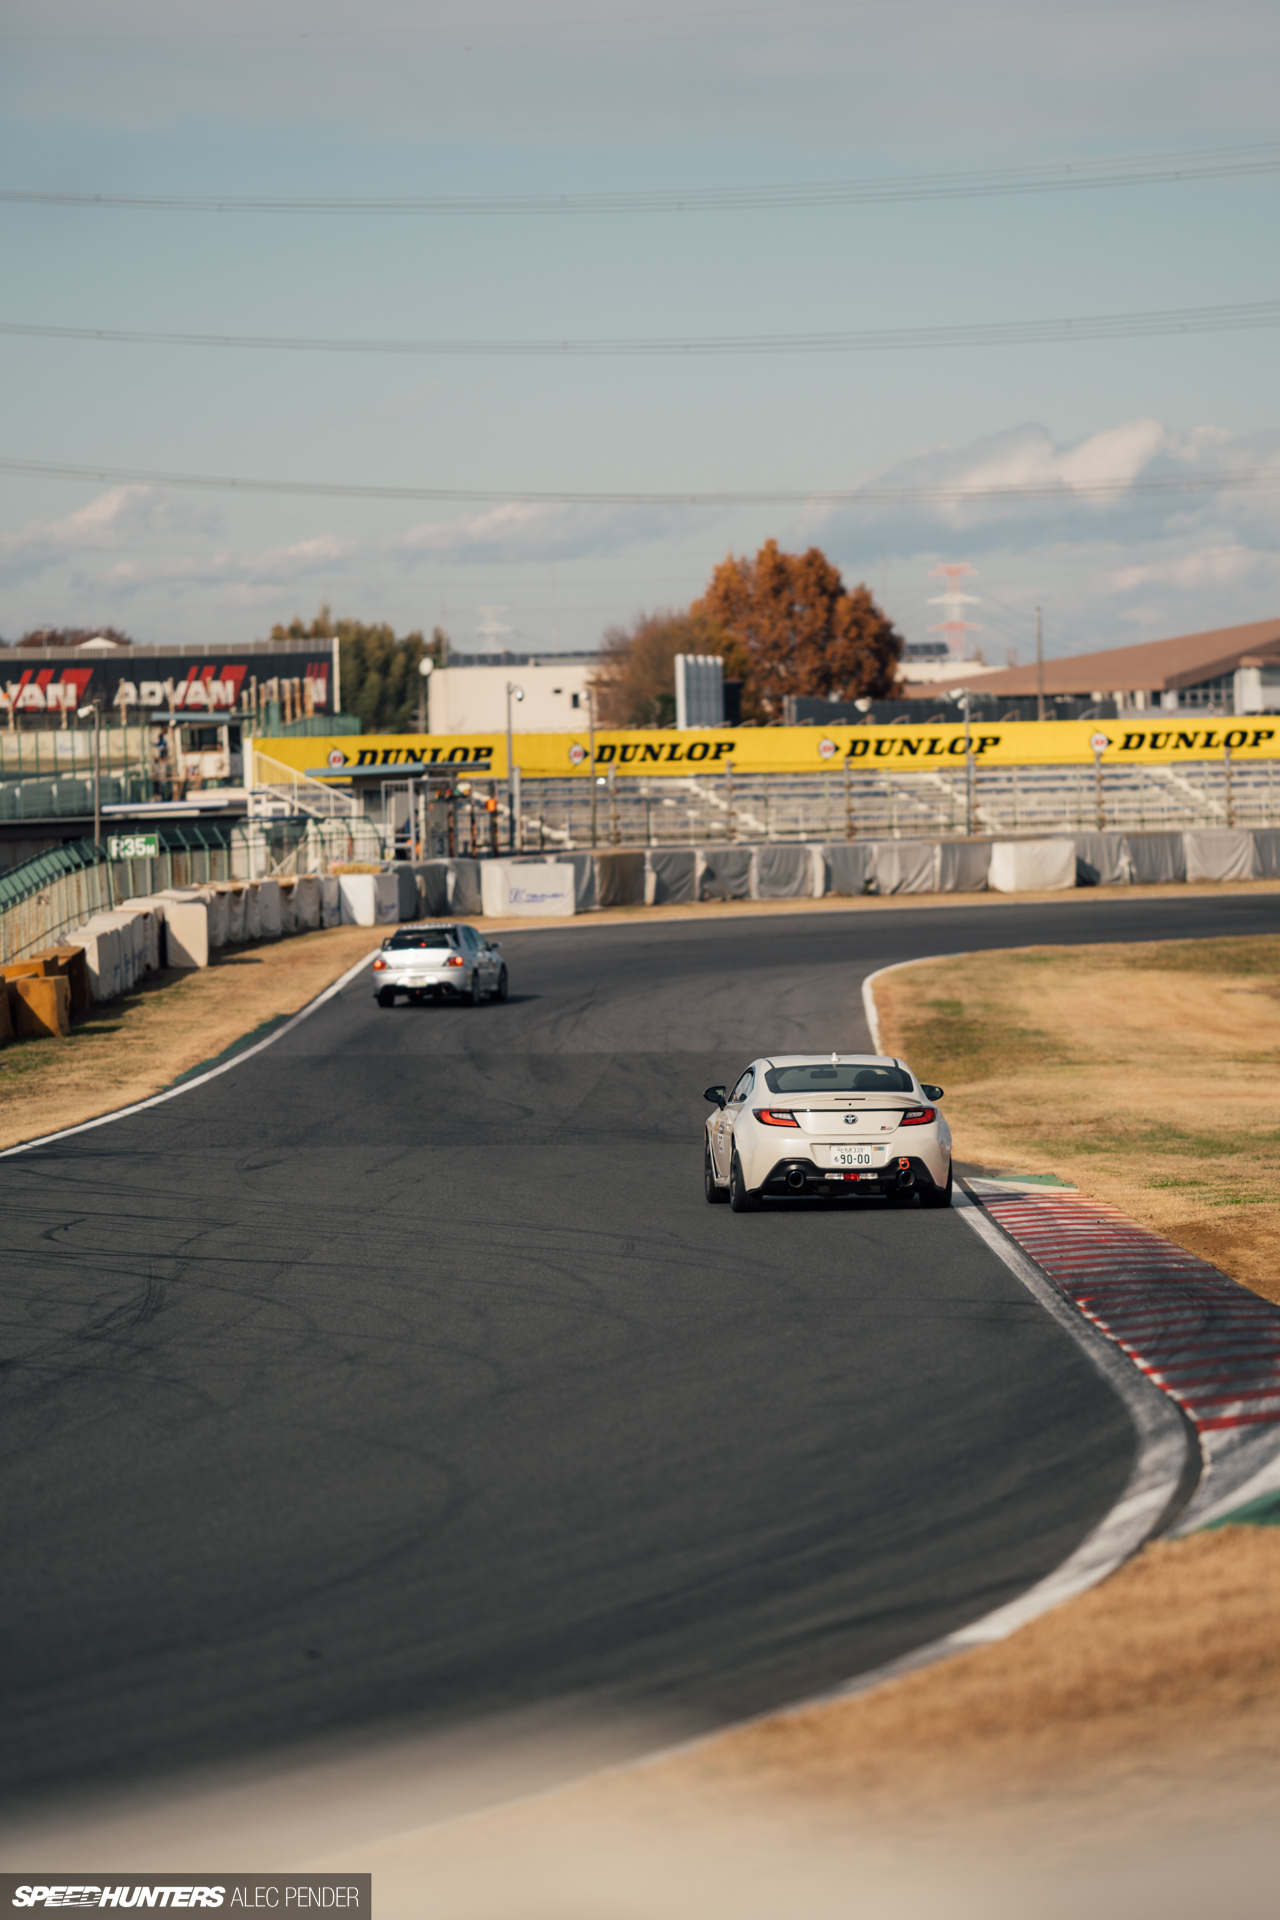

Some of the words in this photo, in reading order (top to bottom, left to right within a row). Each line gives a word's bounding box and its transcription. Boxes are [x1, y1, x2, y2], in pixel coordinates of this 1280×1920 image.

[113, 680, 235, 706] ADVAN
[846, 736, 1001, 757] DUNLOP
[1118, 730, 1275, 750] DUNLOP
[355, 747, 494, 766] DUNLOP
[594, 742, 736, 762] DUNLOP
[840, 1154, 870, 1164] 90-00
